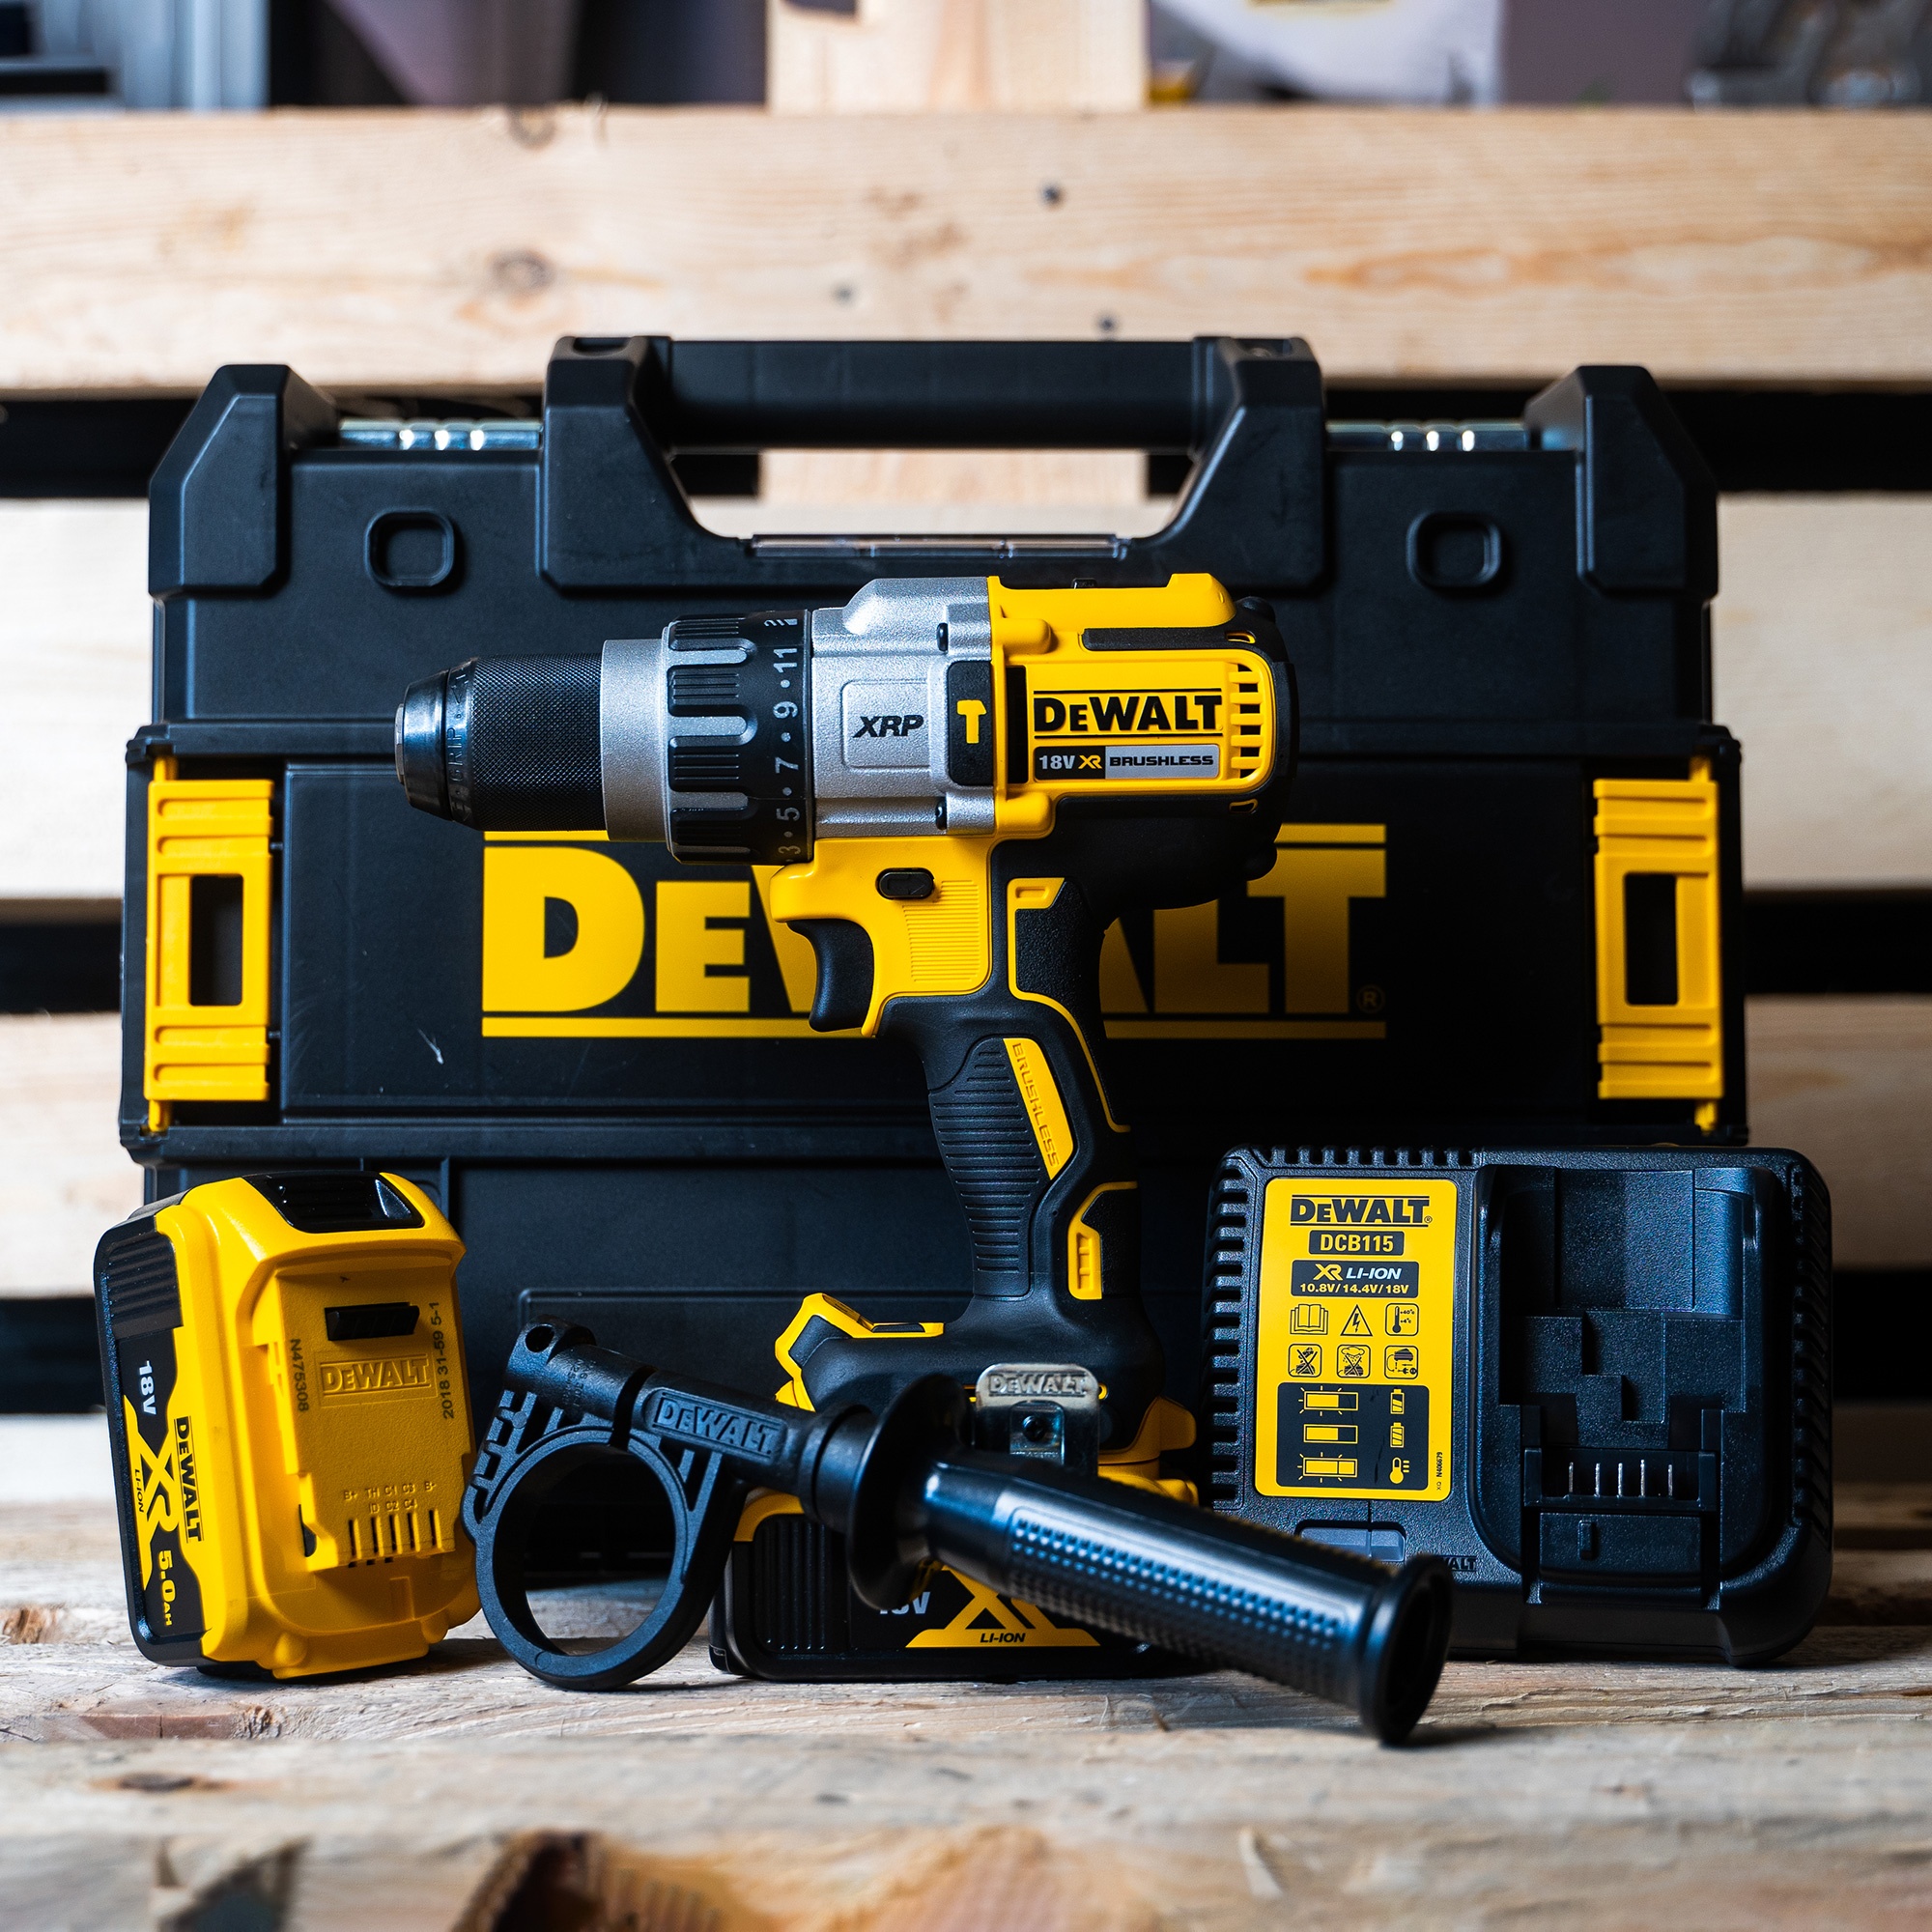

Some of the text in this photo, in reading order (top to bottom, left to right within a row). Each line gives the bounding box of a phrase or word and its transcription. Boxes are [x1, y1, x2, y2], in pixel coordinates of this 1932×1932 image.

[774, 648, 798, 673] 11
[774, 701, 798, 719] 9
[1033, 695, 1222, 732] DEWALT
[853, 714, 924, 738] XRP
[447, 726, 464, 781] GRIP
[775, 756, 799, 774] 7
[1038, 754, 1214, 770] 18V XR BRUSHLESS
[776, 807, 801, 821] 5
[1011, 1042, 1060, 1167] BRUSHLESS
[1291, 1198, 1430, 1224] DEWALT
[1320, 1234, 1394, 1253] DCB115
[1313, 1264, 1403, 1281] XR LI-ION
[429, 1301, 455, 1420] 2018 31-59 5-1
[138, 1360, 157, 1416] 18V
[291, 1338, 310, 1412] N475308
[320, 1356, 430, 1394] DEWALT
[986, 1371, 1088, 1394] DEWALT
[655, 1396, 780, 1454] DEWALT
[134, 1468, 145, 1513] LI-ION
[174, 1416, 203, 1543] DEWALT
[980, 1633, 1026, 1643] LI-ION
